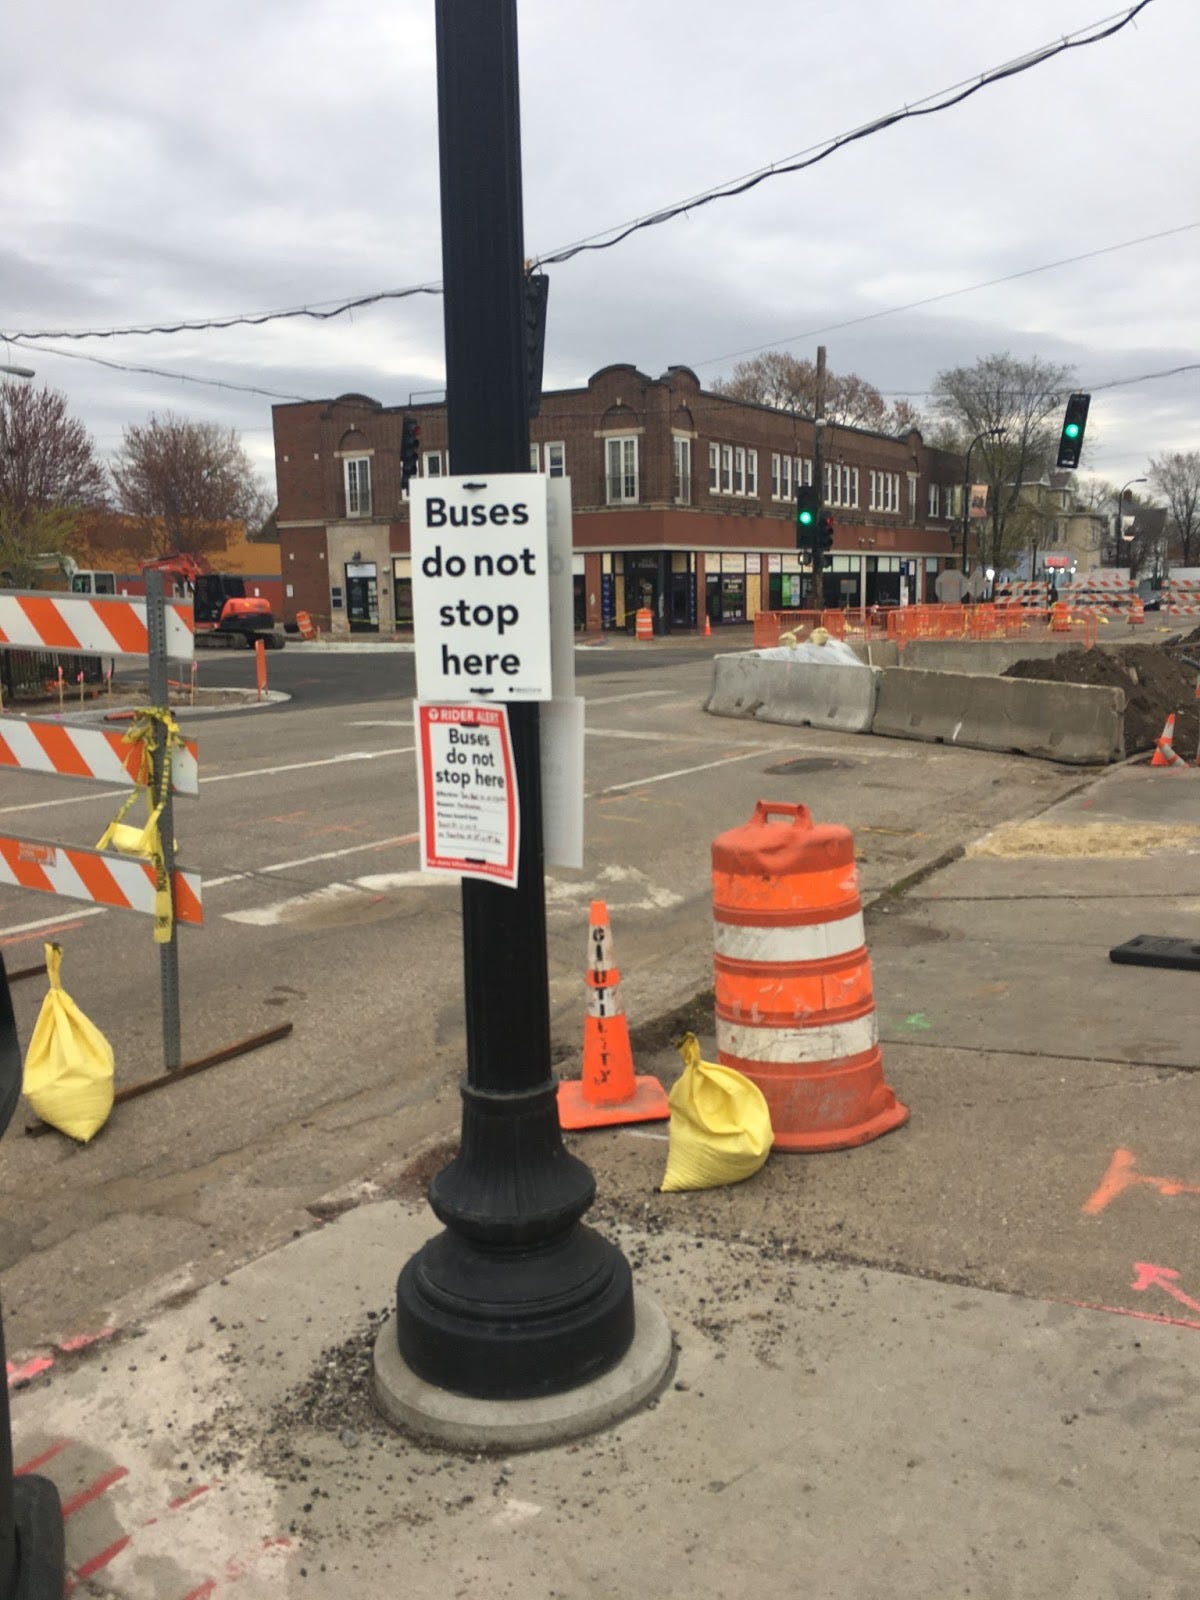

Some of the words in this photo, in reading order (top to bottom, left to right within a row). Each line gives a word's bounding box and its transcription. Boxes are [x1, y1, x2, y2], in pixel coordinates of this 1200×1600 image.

[426, 497, 529, 528] Buses
[422, 545, 466, 577] do
[474, 548, 536, 576] not
[439, 600, 519, 635] stop
[442, 644, 520, 675] here
[440, 709, 474, 722] RIDER
[476, 711, 499, 724] ALERT
[448, 728, 490, 747] Buses
[446, 748, 467, 764] do
[472, 753, 495, 767] not
[436, 768, 471, 789] stop
[475, 768, 504, 789] here
